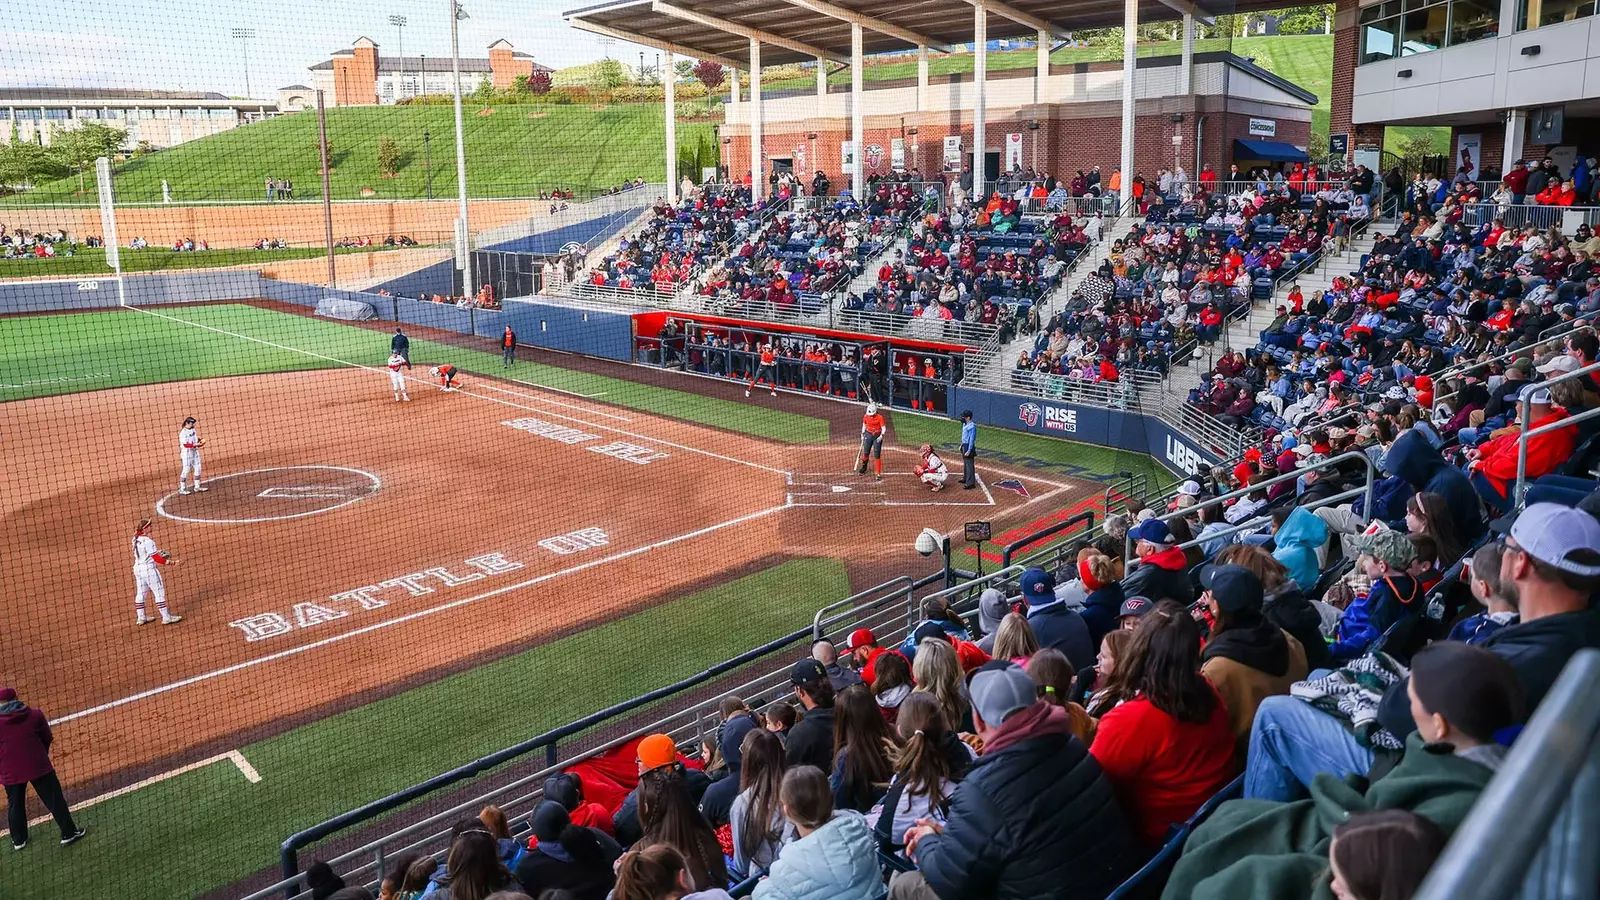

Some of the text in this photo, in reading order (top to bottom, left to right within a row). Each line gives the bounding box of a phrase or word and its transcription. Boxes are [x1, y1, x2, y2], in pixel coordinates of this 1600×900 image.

[1045, 406, 1077, 423] RISE
[1045, 420, 1064, 430] WITH
[229, 551, 525, 642] BATTLE
